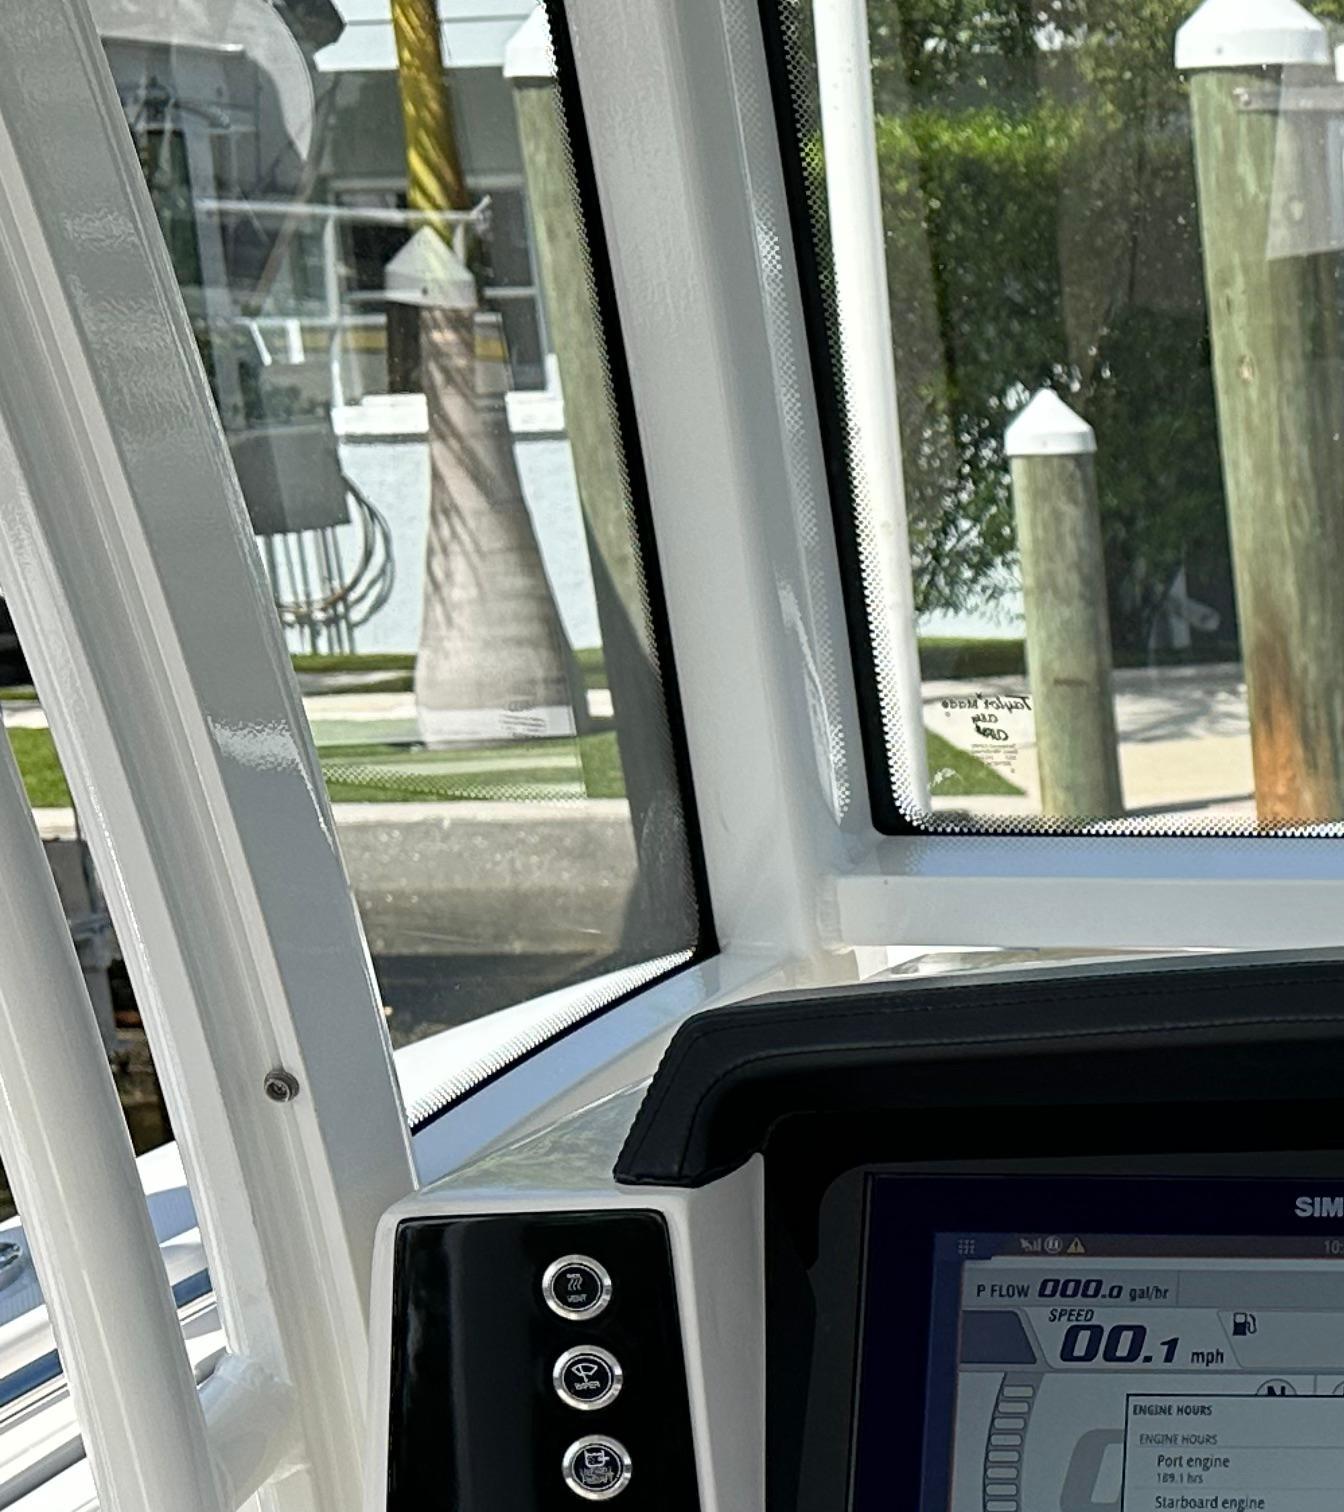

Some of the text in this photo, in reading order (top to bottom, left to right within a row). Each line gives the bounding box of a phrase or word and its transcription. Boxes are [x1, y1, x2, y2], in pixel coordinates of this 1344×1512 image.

[977, 1278, 1169, 1303] P FLOW 000.0 gal/hr
[1048, 1309, 1095, 1323] SPEED
[1059, 1324, 1225, 1366] 00.1 mph
[1133, 1405, 1213, 1417] ENGINE HOURS
[1139, 1434, 1218, 1445] ENGINE HOURS
[1157, 1454, 1230, 1472] Port engine
[1155, 1495, 1265, 1512] Starboard engine
